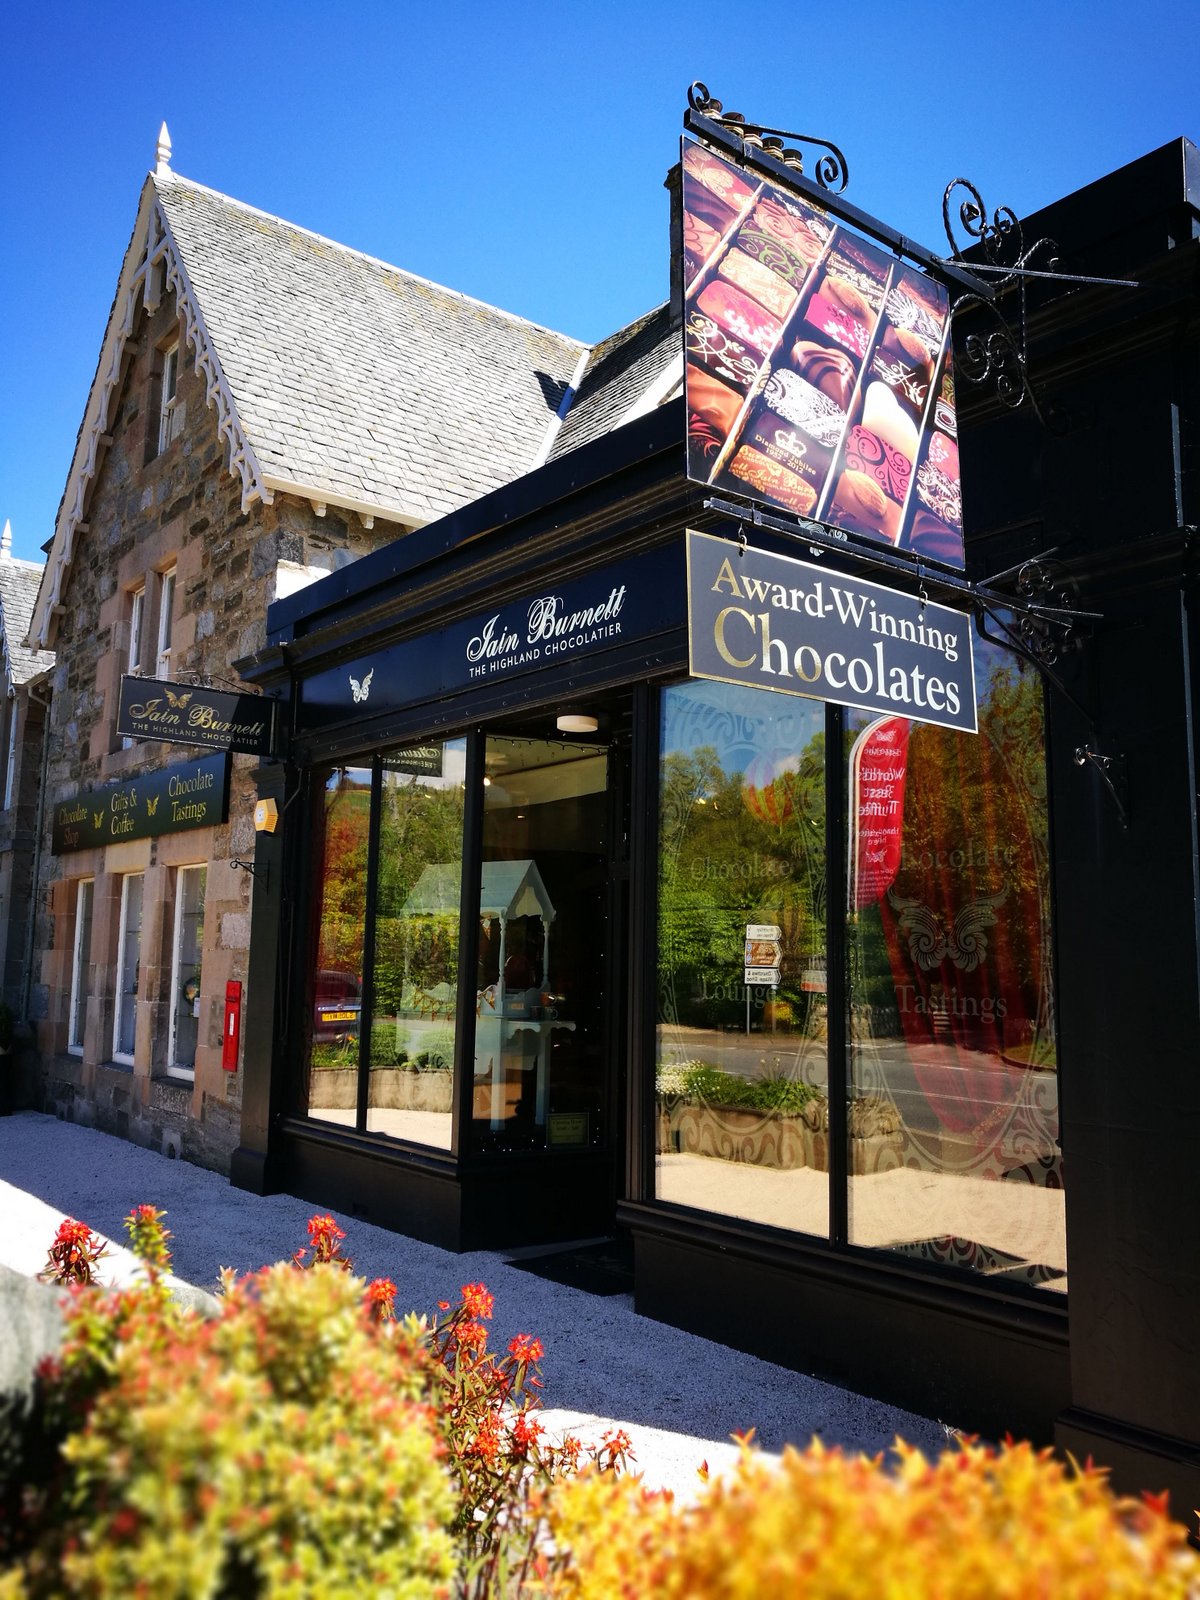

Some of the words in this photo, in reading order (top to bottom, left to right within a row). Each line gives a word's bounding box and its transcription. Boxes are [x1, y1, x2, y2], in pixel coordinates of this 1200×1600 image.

[755, 434, 788, 457] Diamond
[790, 454, 817, 475] Jubilee
[765, 447, 782, 460] 1952
[786, 460, 804, 473] 2012
[466, 614, 520, 663] Iain
[527, 585, 627, 644] Burnett
[711, 557, 958, 662] Award-Winning
[469, 664, 486, 678] THE
[490, 649, 540, 672] HIGHLAND
[544, 623, 622, 656] CHOCOLATIER
[713, 606, 961, 715] Chocolates
[129, 699, 180, 725] Iain
[188, 703, 265, 737] Burnett
[132, 722, 149, 731] THE
[152, 725, 197, 737] HIGHLAND
[201, 732, 258, 745] CHOCOLATIER
[168, 768, 214, 797] Chocolate
[58, 803, 87, 826] Chocolate
[111, 792, 128, 812] Gifts
[129, 788, 137, 806] &
[171, 800, 207, 823] Tastings
[64, 829, 79, 847] Shop
[111, 812, 135, 835] Coffee
[702, 977, 777, 1008] Lounge
[894, 985, 1008, 1024] Tastings
